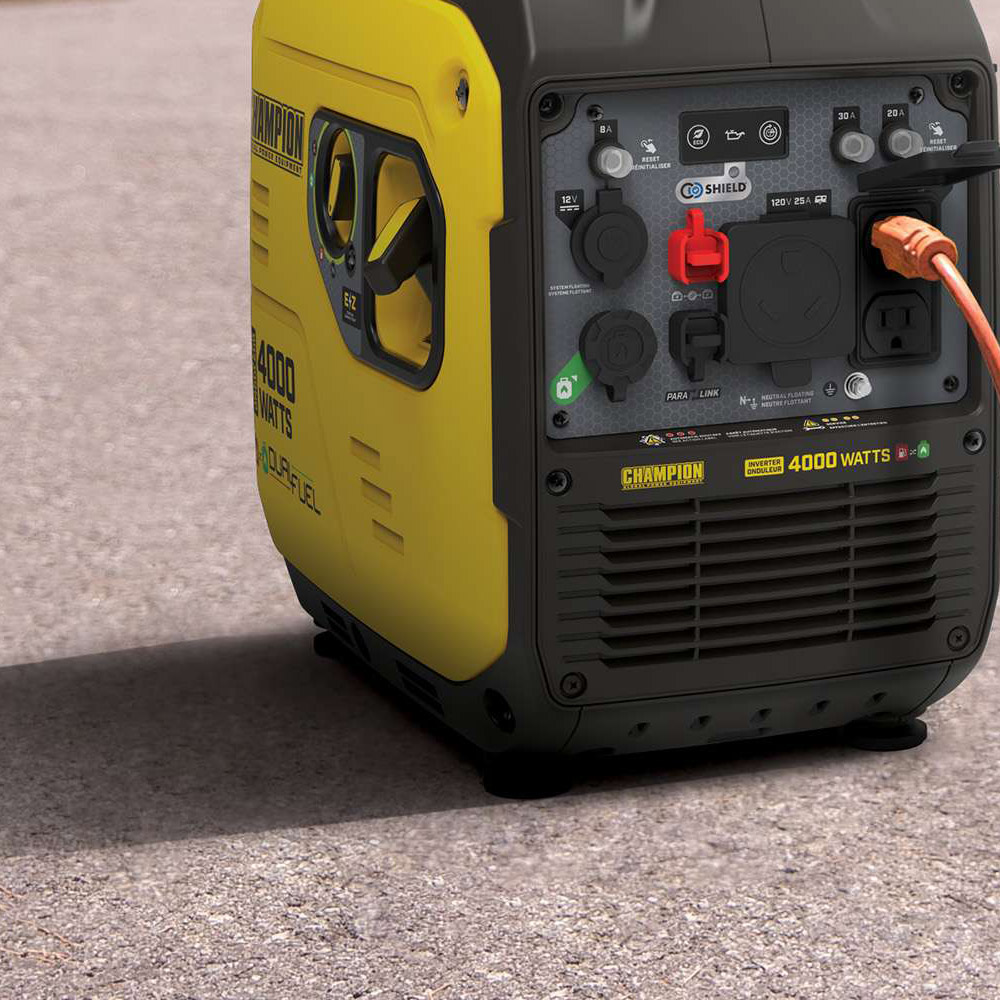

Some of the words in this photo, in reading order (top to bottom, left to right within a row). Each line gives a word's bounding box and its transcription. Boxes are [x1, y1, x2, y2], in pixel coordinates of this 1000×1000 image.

[705, 182, 747, 195] SHIELD
[258, 340, 296, 404] 4000
[259, 388, 293, 439] WATTS
[748, 458, 781, 467] INVERTER
[788, 451, 837, 472] 4000
[840, 448, 891, 467] WATTS
[623, 463, 703, 484] CHAMPION
[747, 466, 782, 476] ONDULEUR
